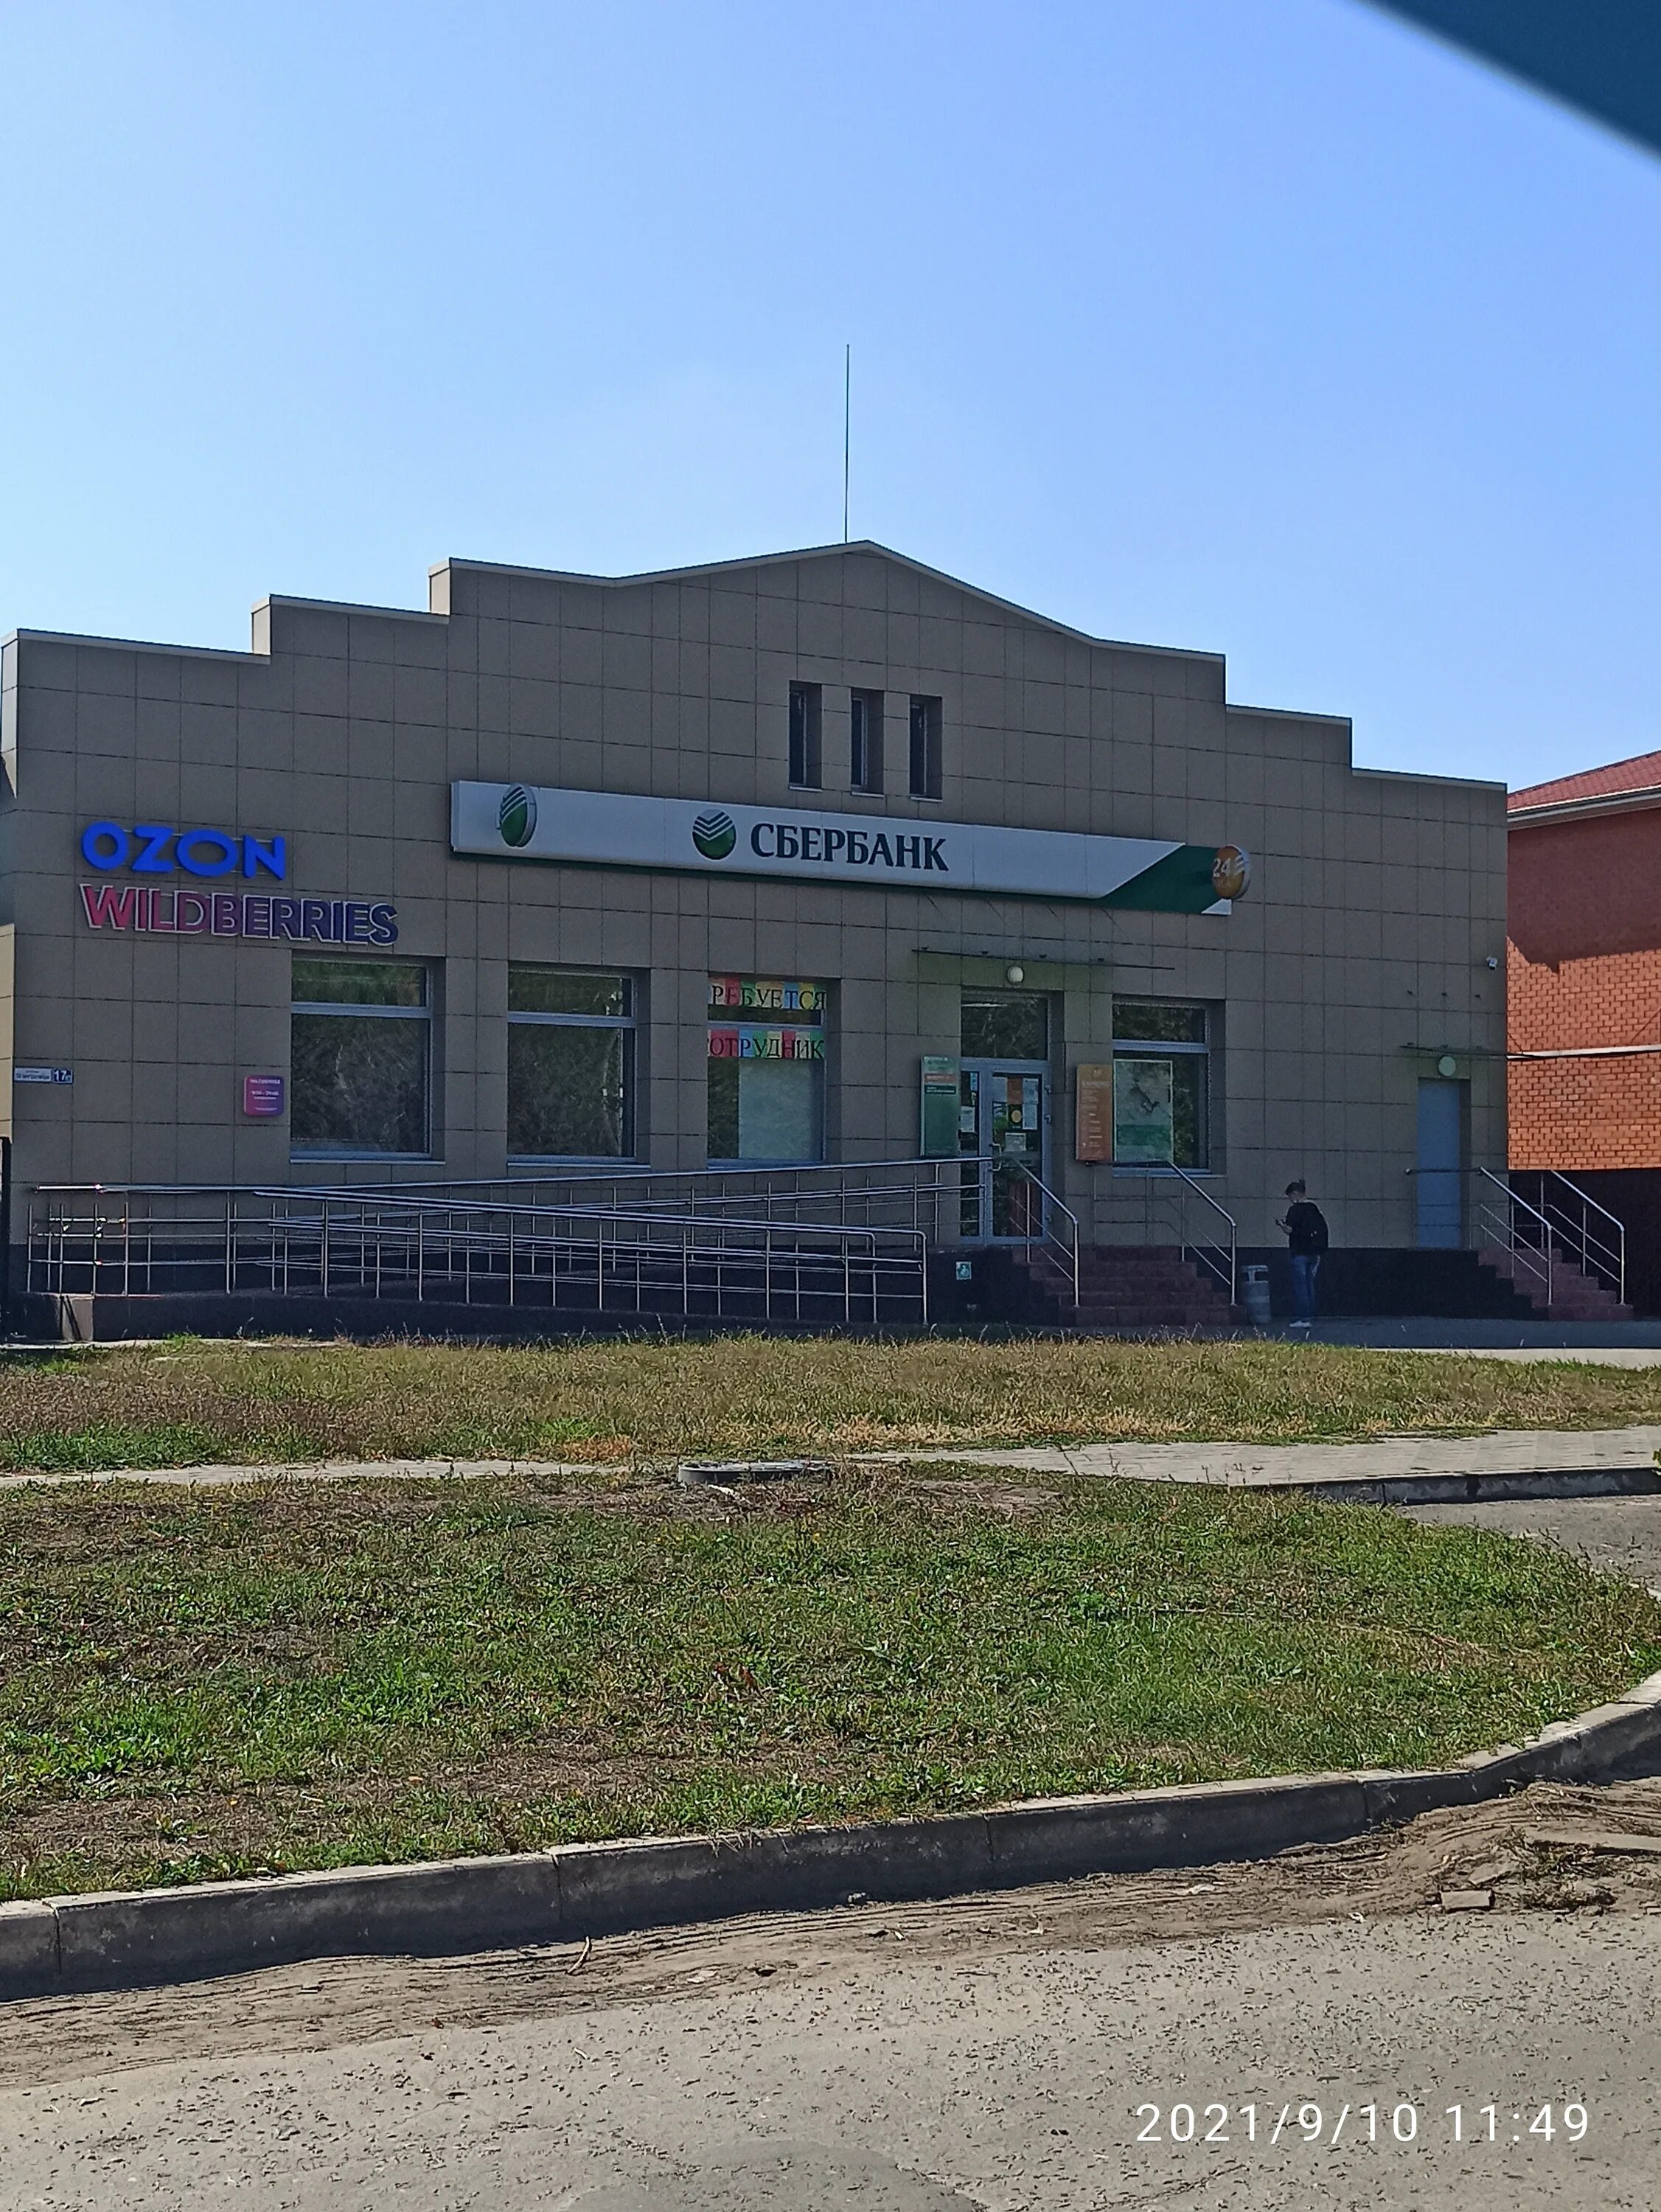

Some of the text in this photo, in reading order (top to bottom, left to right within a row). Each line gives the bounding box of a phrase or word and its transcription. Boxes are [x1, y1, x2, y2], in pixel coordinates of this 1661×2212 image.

[81, 821, 286, 880] OZON
[751, 823, 949, 872] СБЕРБАНК
[1213, 858, 1231, 877] 24
[80, 883, 399, 947] WILDBERRIES
[708, 985, 826, 1011] РЕБУЕТСЯ
[707, 1037, 825, 1060] ОТРУДНИК
